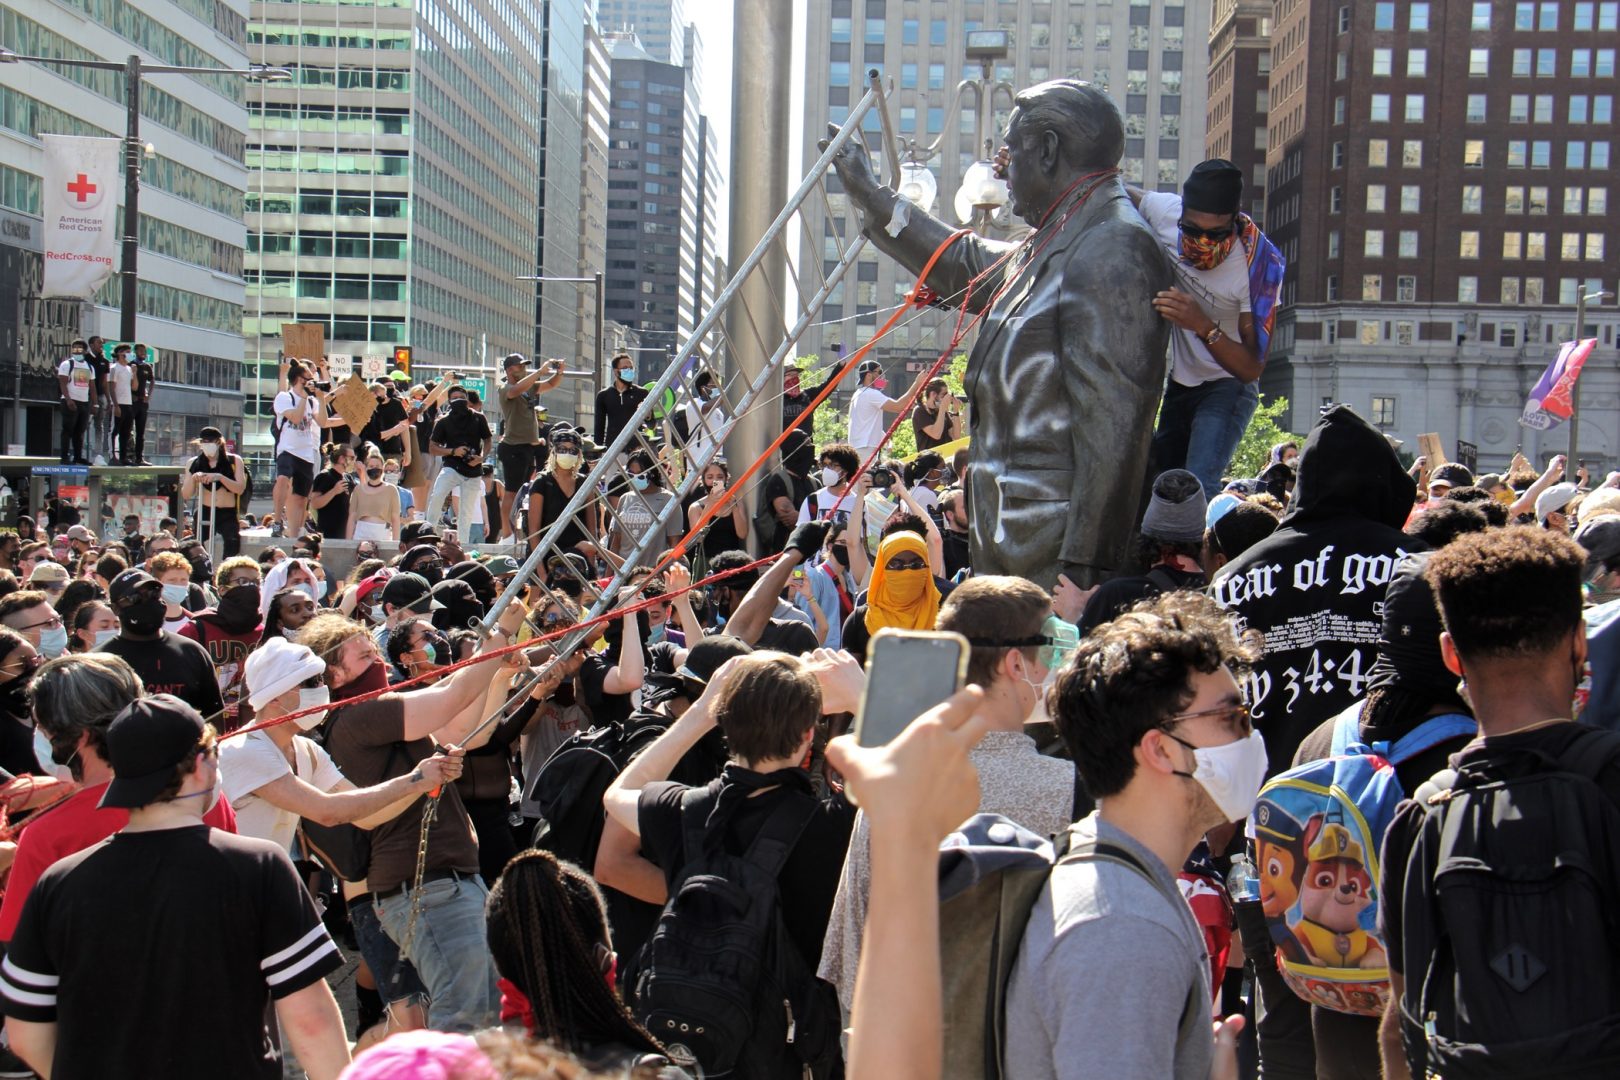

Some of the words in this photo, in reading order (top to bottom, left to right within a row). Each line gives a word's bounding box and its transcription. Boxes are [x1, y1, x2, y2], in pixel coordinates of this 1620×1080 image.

[60, 216, 103, 224] American
[46, 251, 112, 265] RedCross.org
[335, 357, 346, 365] NO
[1524, 411, 1546, 421] LOVE
[1523, 419, 1545, 427] PARK
[1293, 545, 1335, 591] of
